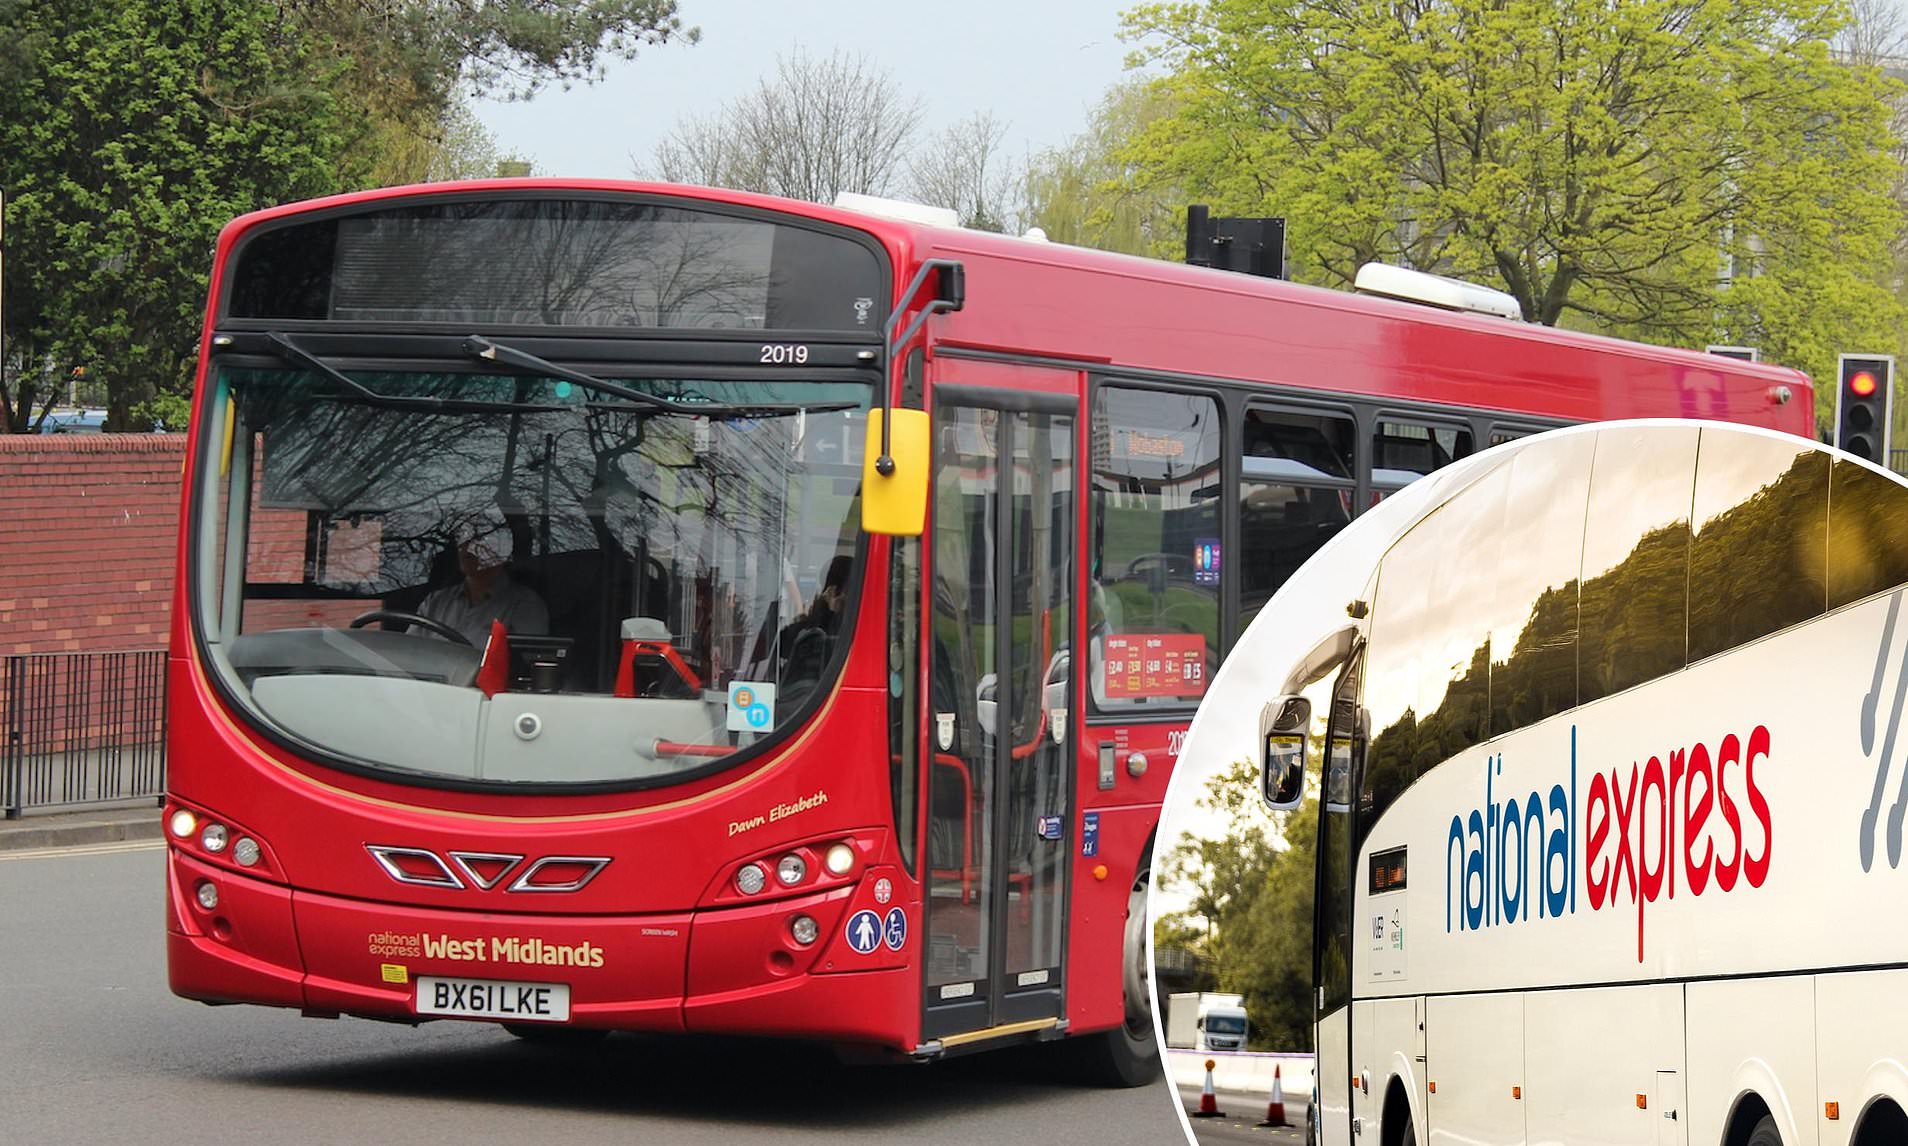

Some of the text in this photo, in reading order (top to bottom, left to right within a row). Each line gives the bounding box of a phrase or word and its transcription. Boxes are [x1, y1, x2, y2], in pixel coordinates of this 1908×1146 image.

[760, 345, 808, 363] 2019
[728, 790, 829, 837] Dawn Elizabeth
[1446, 724, 1772, 964] national express
[368, 931, 420, 947] national
[368, 944, 421, 959] express
[422, 934, 604, 968] West Midlands
